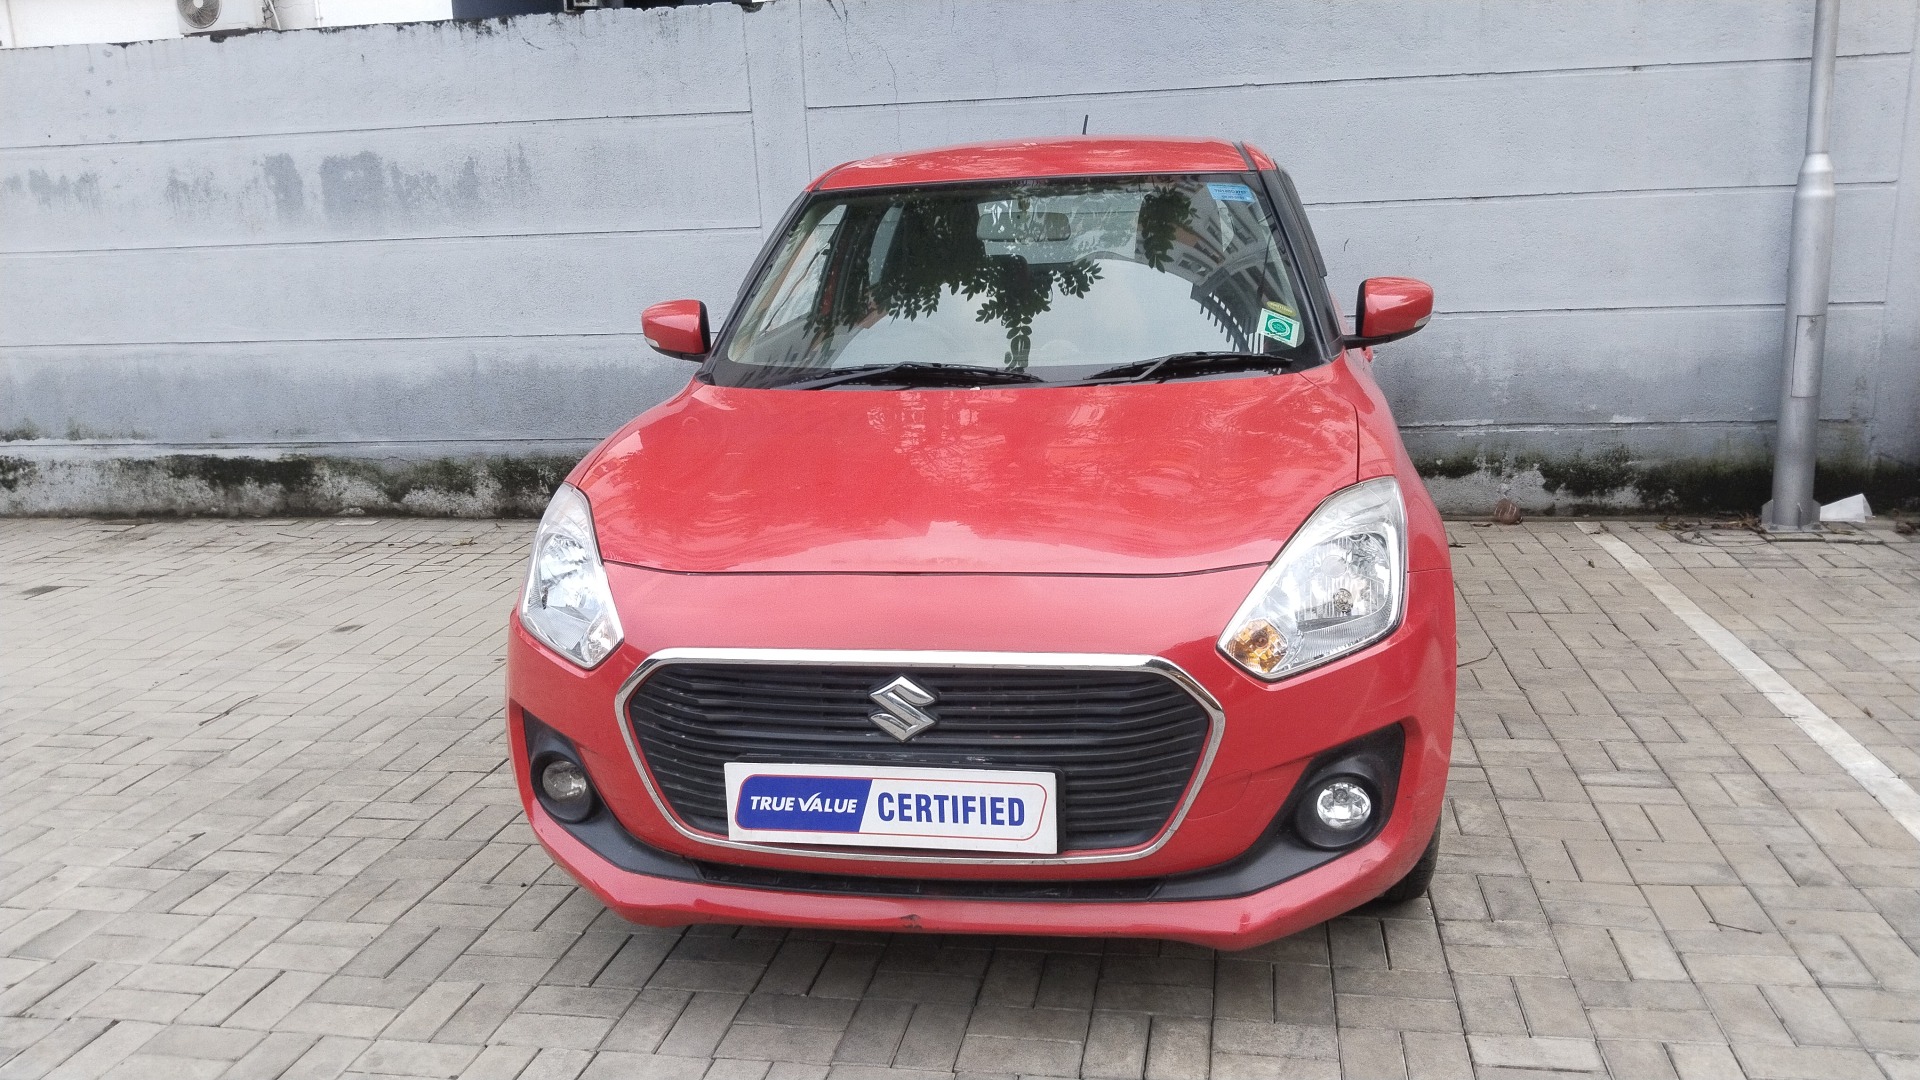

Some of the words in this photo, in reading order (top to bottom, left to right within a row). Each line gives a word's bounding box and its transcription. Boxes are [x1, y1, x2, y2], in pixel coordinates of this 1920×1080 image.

[751, 796, 795, 811] TRUE
[798, 792, 857, 813] VALUE
[877, 792, 1025, 827] CERTIFIED
